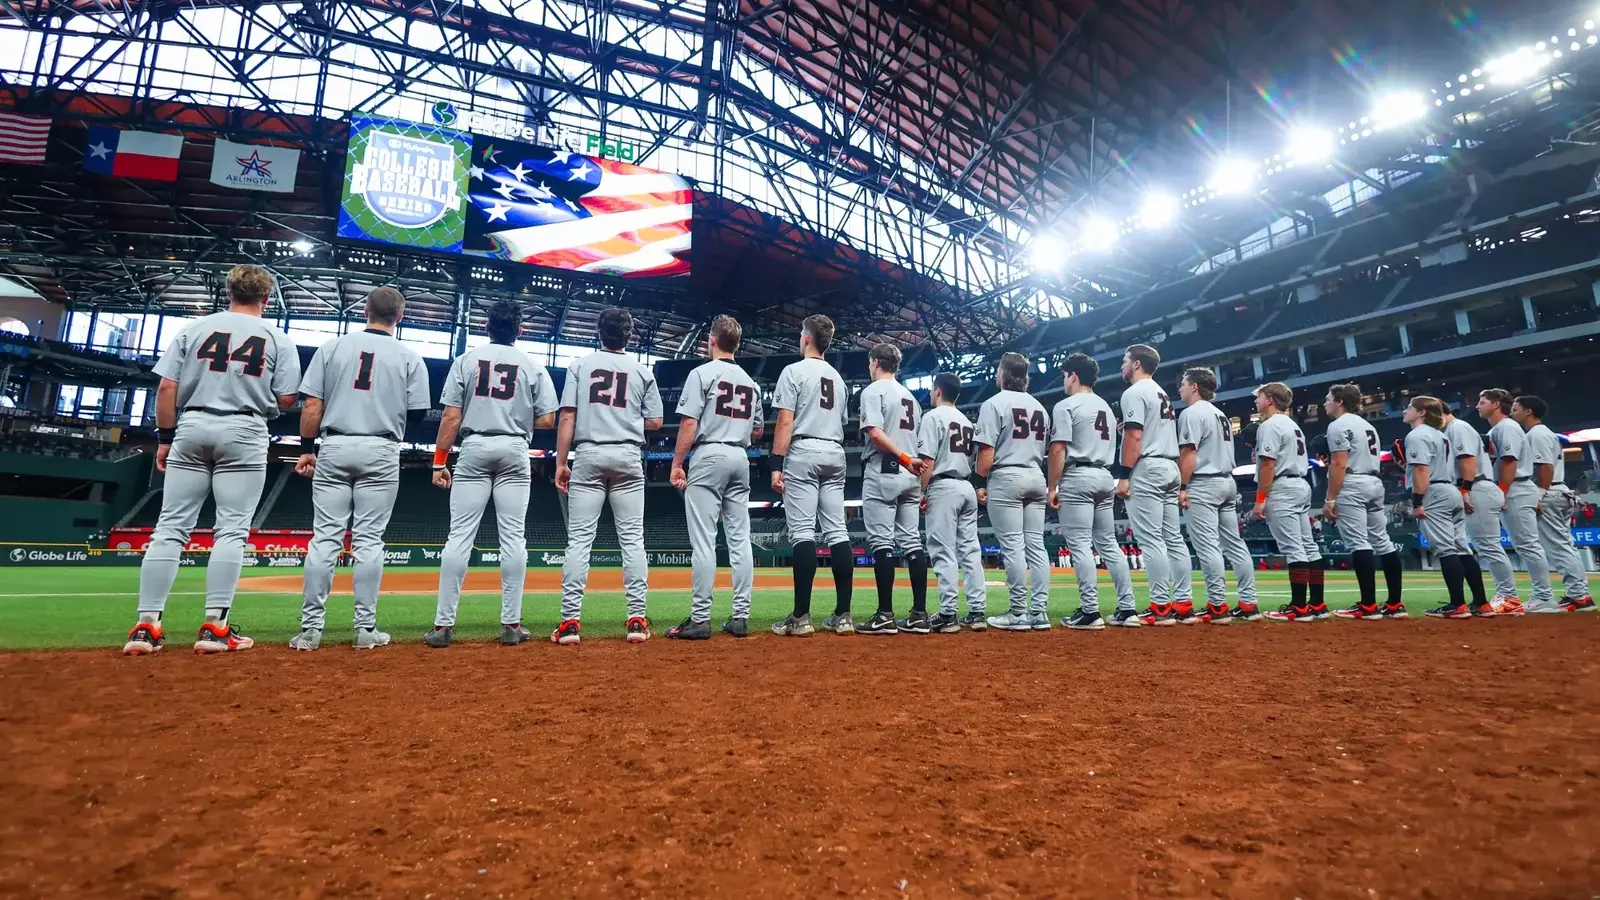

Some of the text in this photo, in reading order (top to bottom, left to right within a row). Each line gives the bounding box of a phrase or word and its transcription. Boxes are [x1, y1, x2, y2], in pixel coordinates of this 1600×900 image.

[586, 134, 634, 161] Field
[225, 174, 277, 186] ARLINGTON
[197, 331, 267, 378] 44
[354, 350, 375, 391] 1
[475, 359, 520, 401] 13
[589, 369, 629, 409] 21
[820, 376, 835, 410] 9
[715, 380, 754, 420] 23
[899, 397, 915, 431] 3
[949, 421, 974, 457] 28
[1012, 407, 1046, 442] 54
[1094, 410, 1110, 441] 4
[1365, 429, 1378, 456] 2
[29, 550, 87, 560] Globe Life
[384, 549, 411, 559] ional
[656, 553, 692, 564] Mobile
